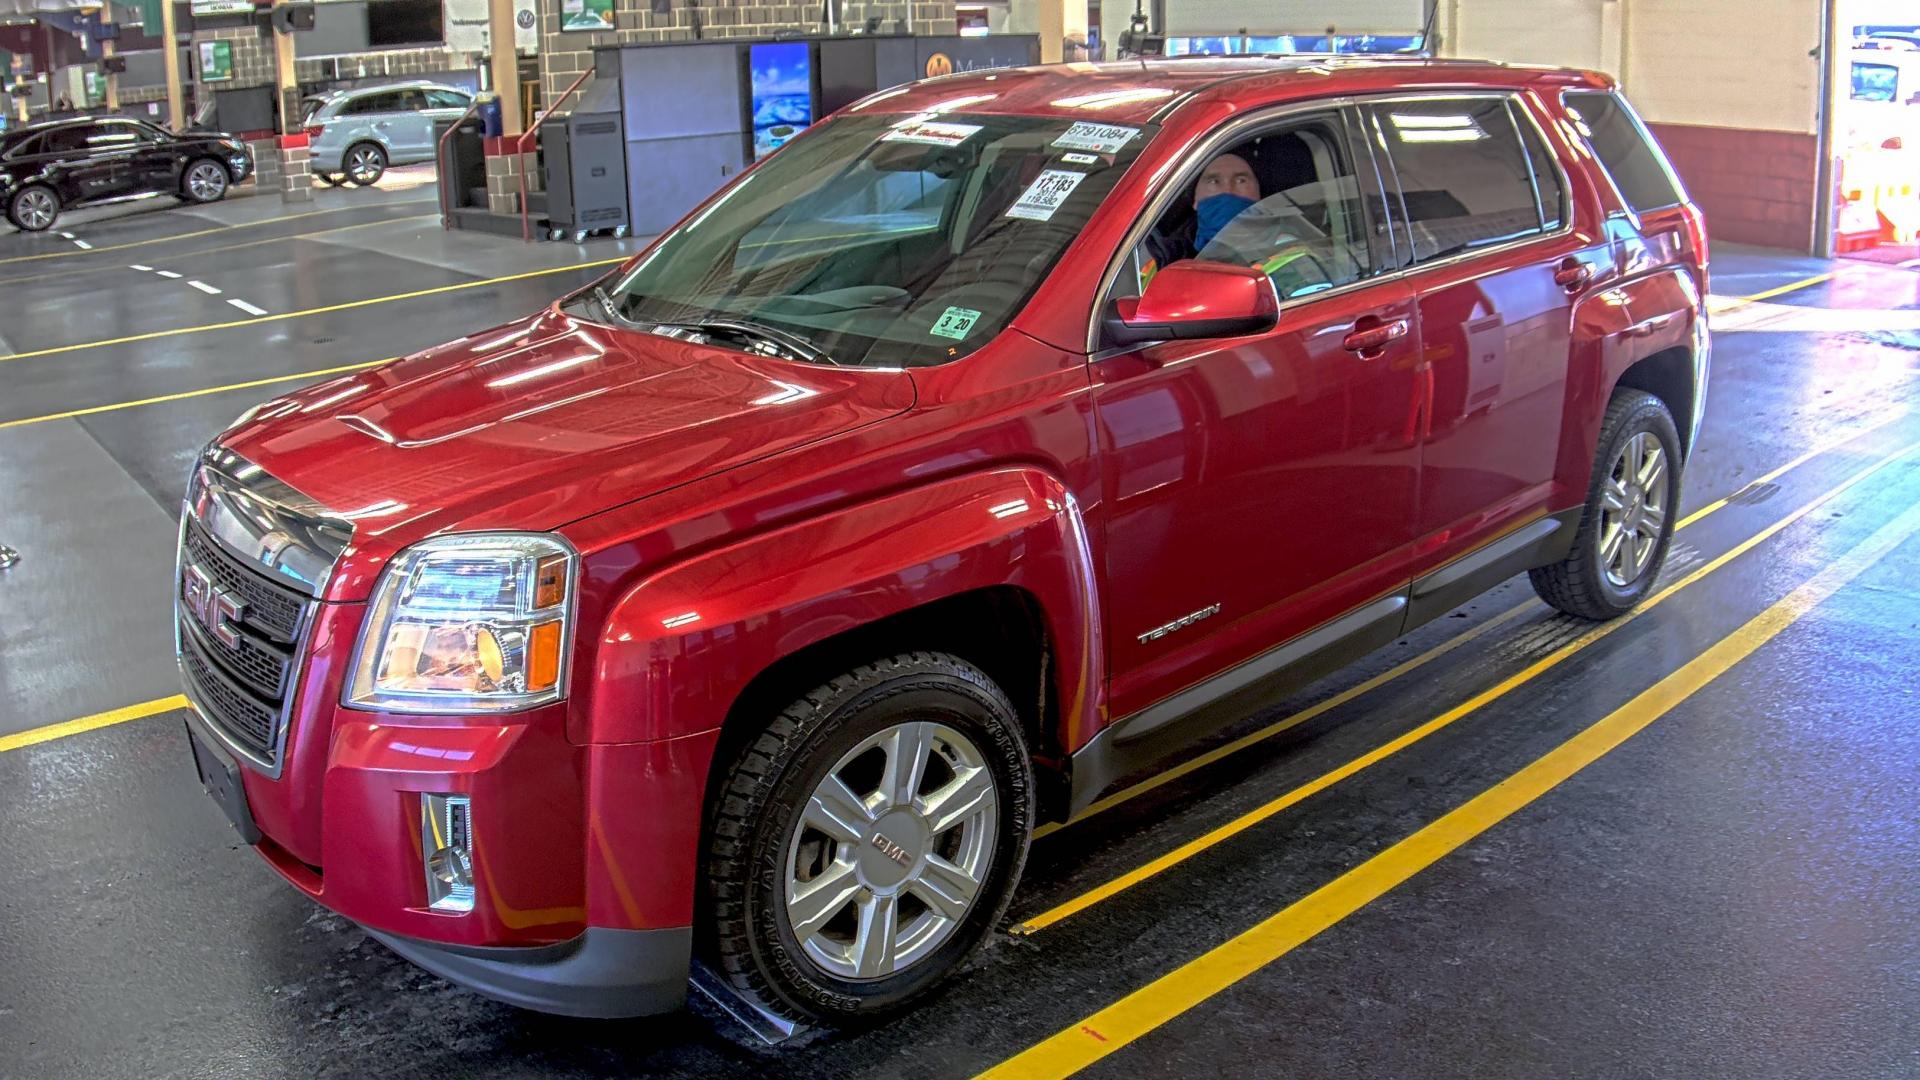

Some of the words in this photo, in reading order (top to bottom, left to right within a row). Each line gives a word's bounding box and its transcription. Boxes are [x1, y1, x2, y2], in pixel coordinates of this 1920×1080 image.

[1069, 125, 1129, 140] 6791084
[941, 316, 952, 327] 3
[954, 318, 970, 331] 20
[184, 563, 243, 651] GMC
[1137, 602, 1221, 645] TERRAIN
[871, 832, 912, 869] GMC
